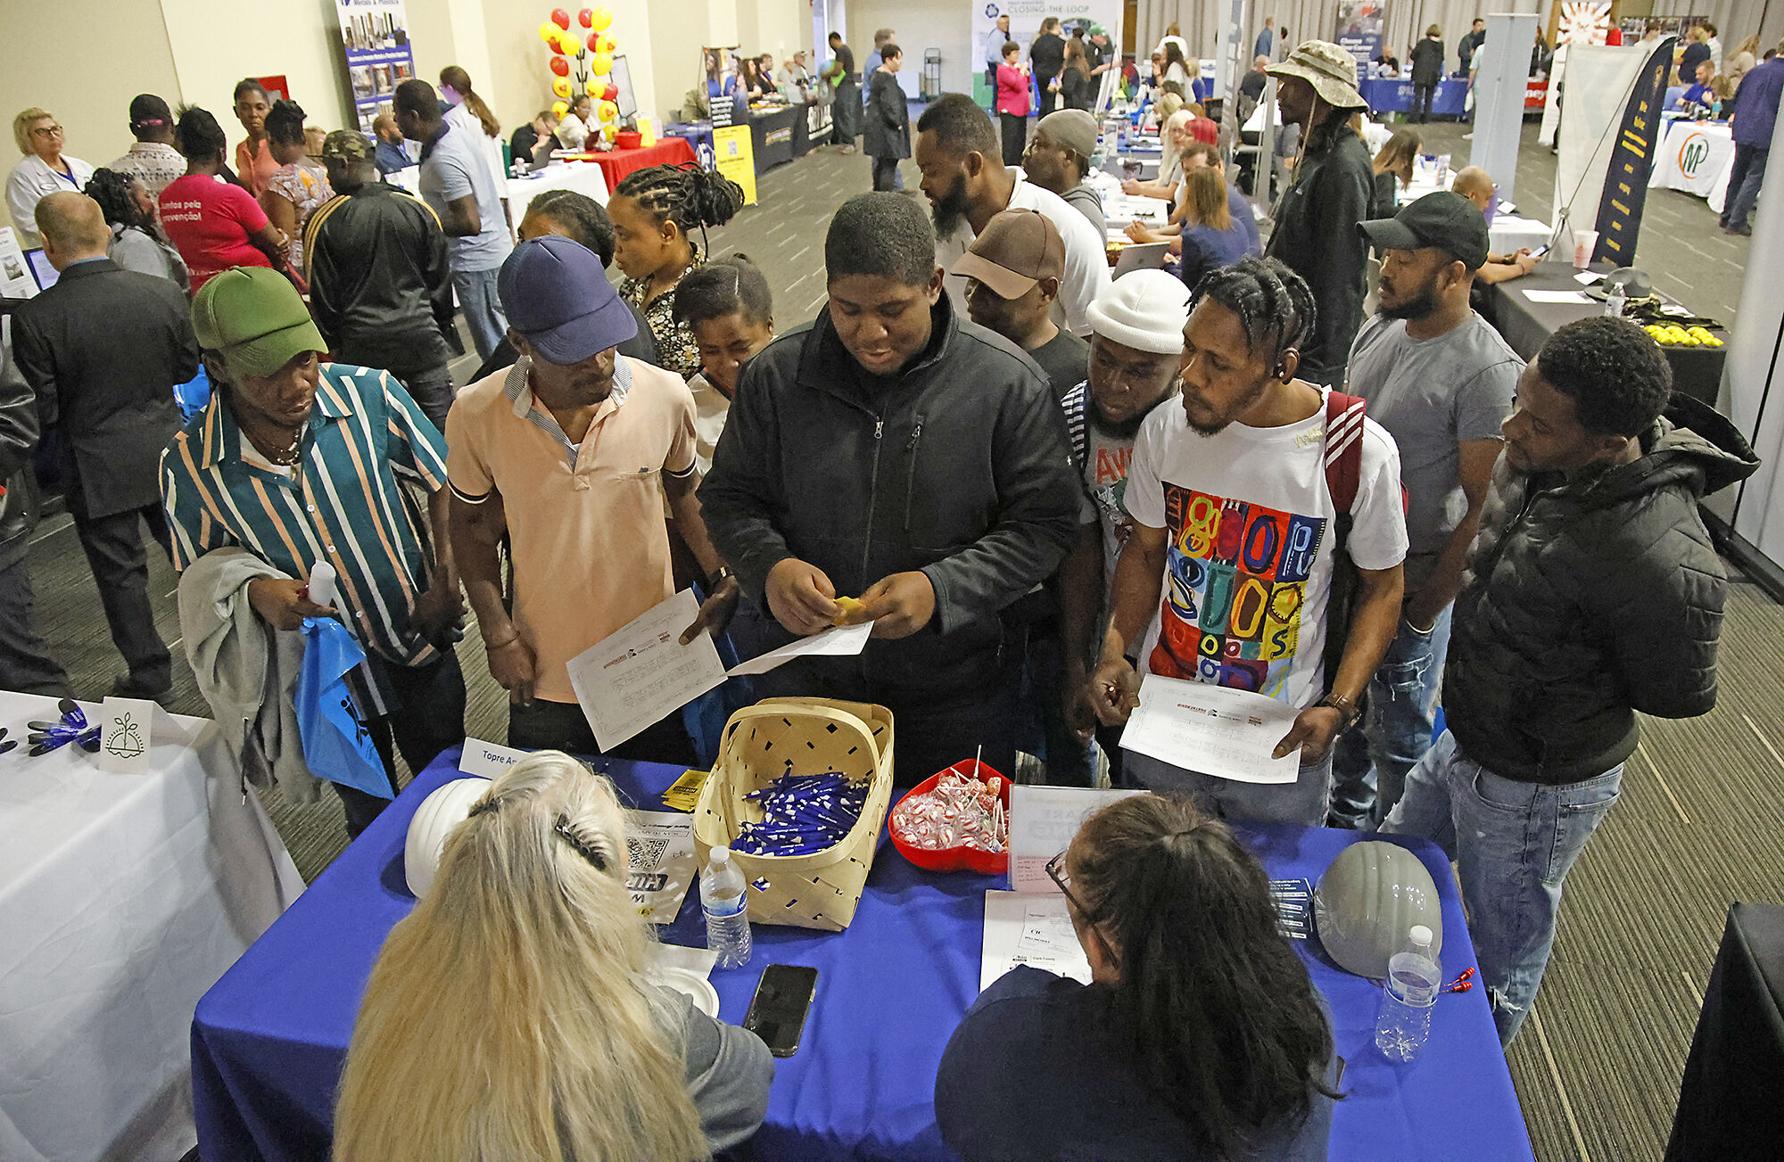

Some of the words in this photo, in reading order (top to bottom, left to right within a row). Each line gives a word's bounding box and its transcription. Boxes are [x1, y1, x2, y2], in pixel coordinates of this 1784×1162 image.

[162, 211, 202, 222] revenção!
[482, 750, 505, 764] Topre
[505, 756, 518, 765] A
